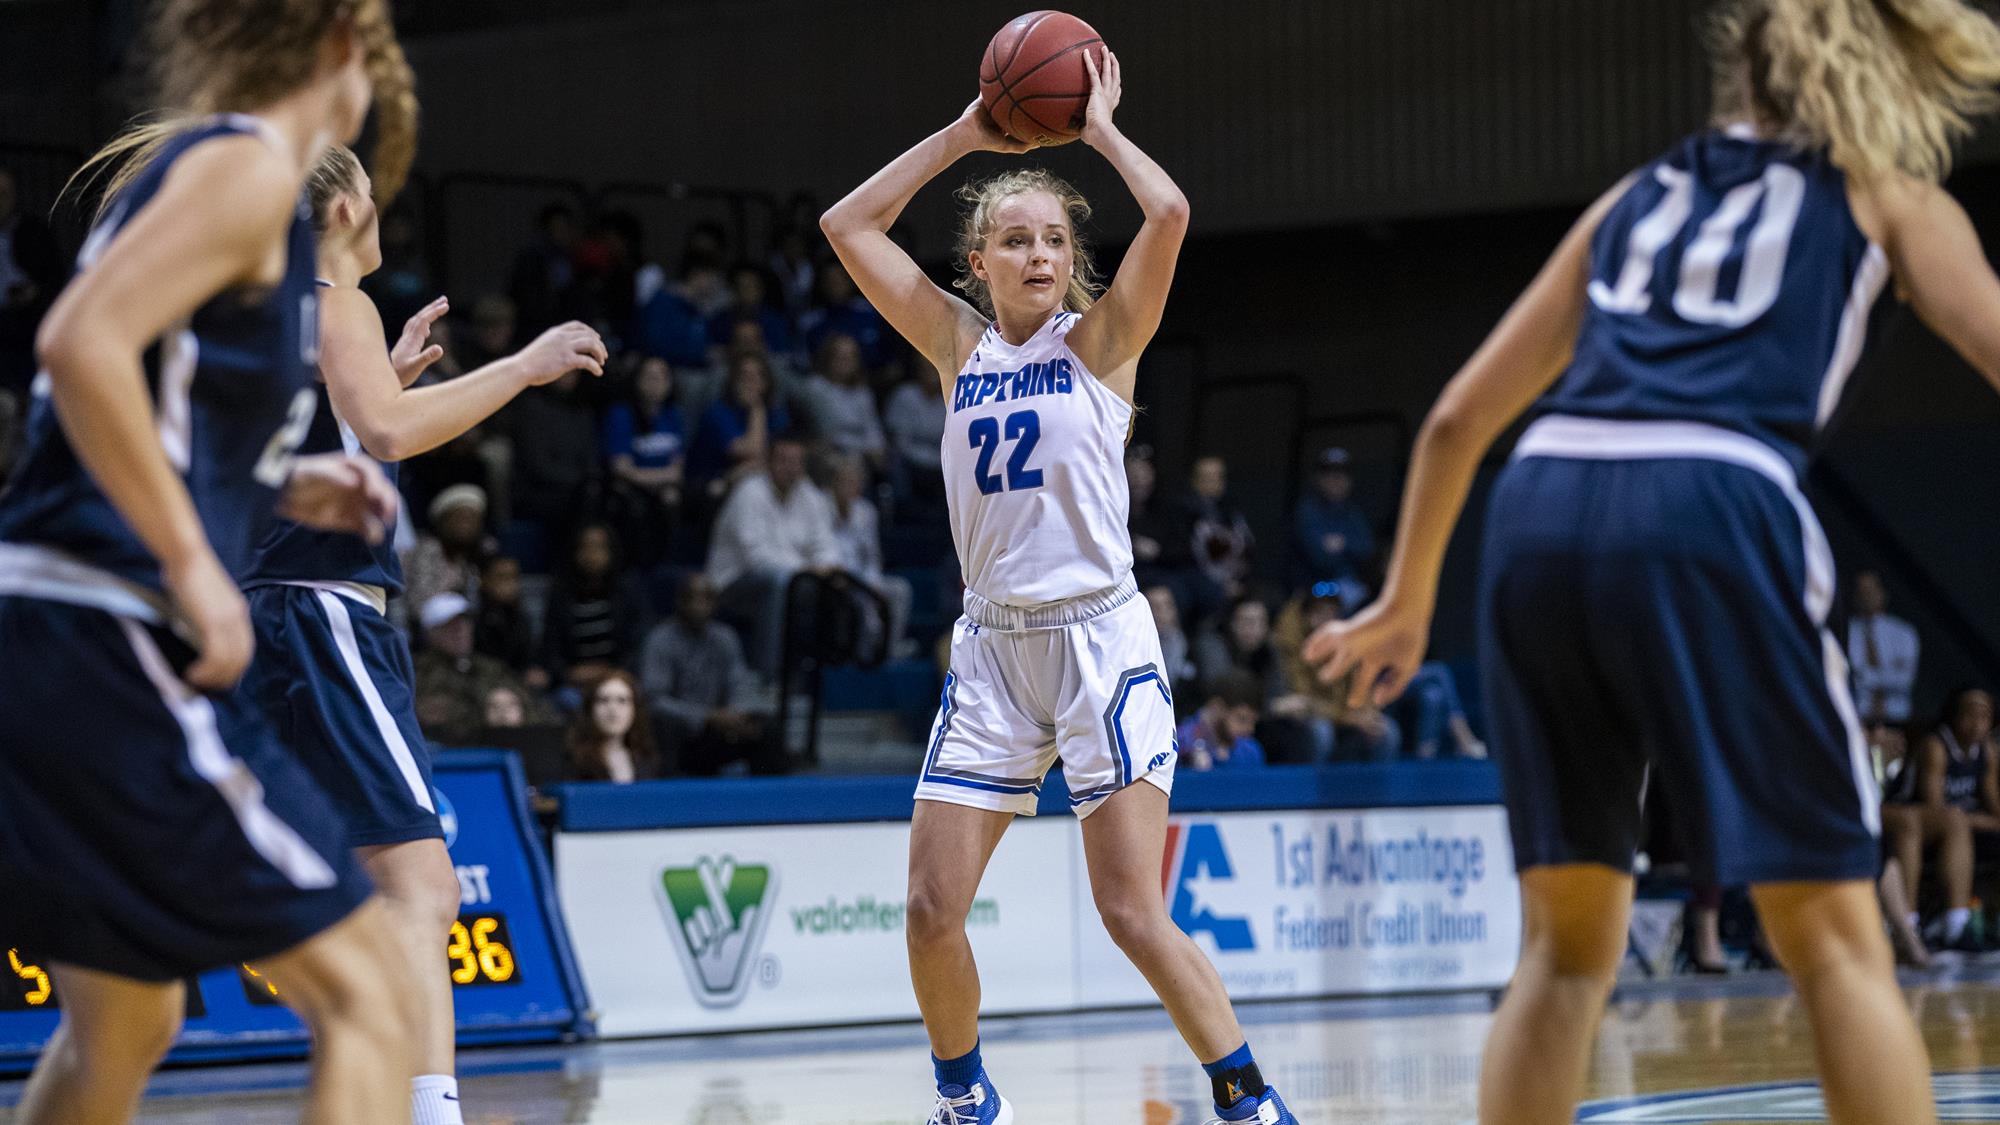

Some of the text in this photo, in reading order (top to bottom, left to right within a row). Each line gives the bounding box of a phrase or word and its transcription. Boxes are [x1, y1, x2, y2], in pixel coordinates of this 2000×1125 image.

[1587, 162, 1805, 329] 10
[954, 358, 1073, 414] CAPTAINS
[968, 409, 1044, 496] 22
[1271, 815, 1486, 898] 1st Advantage
[1274, 899, 1489, 950] Federal Credit Union
